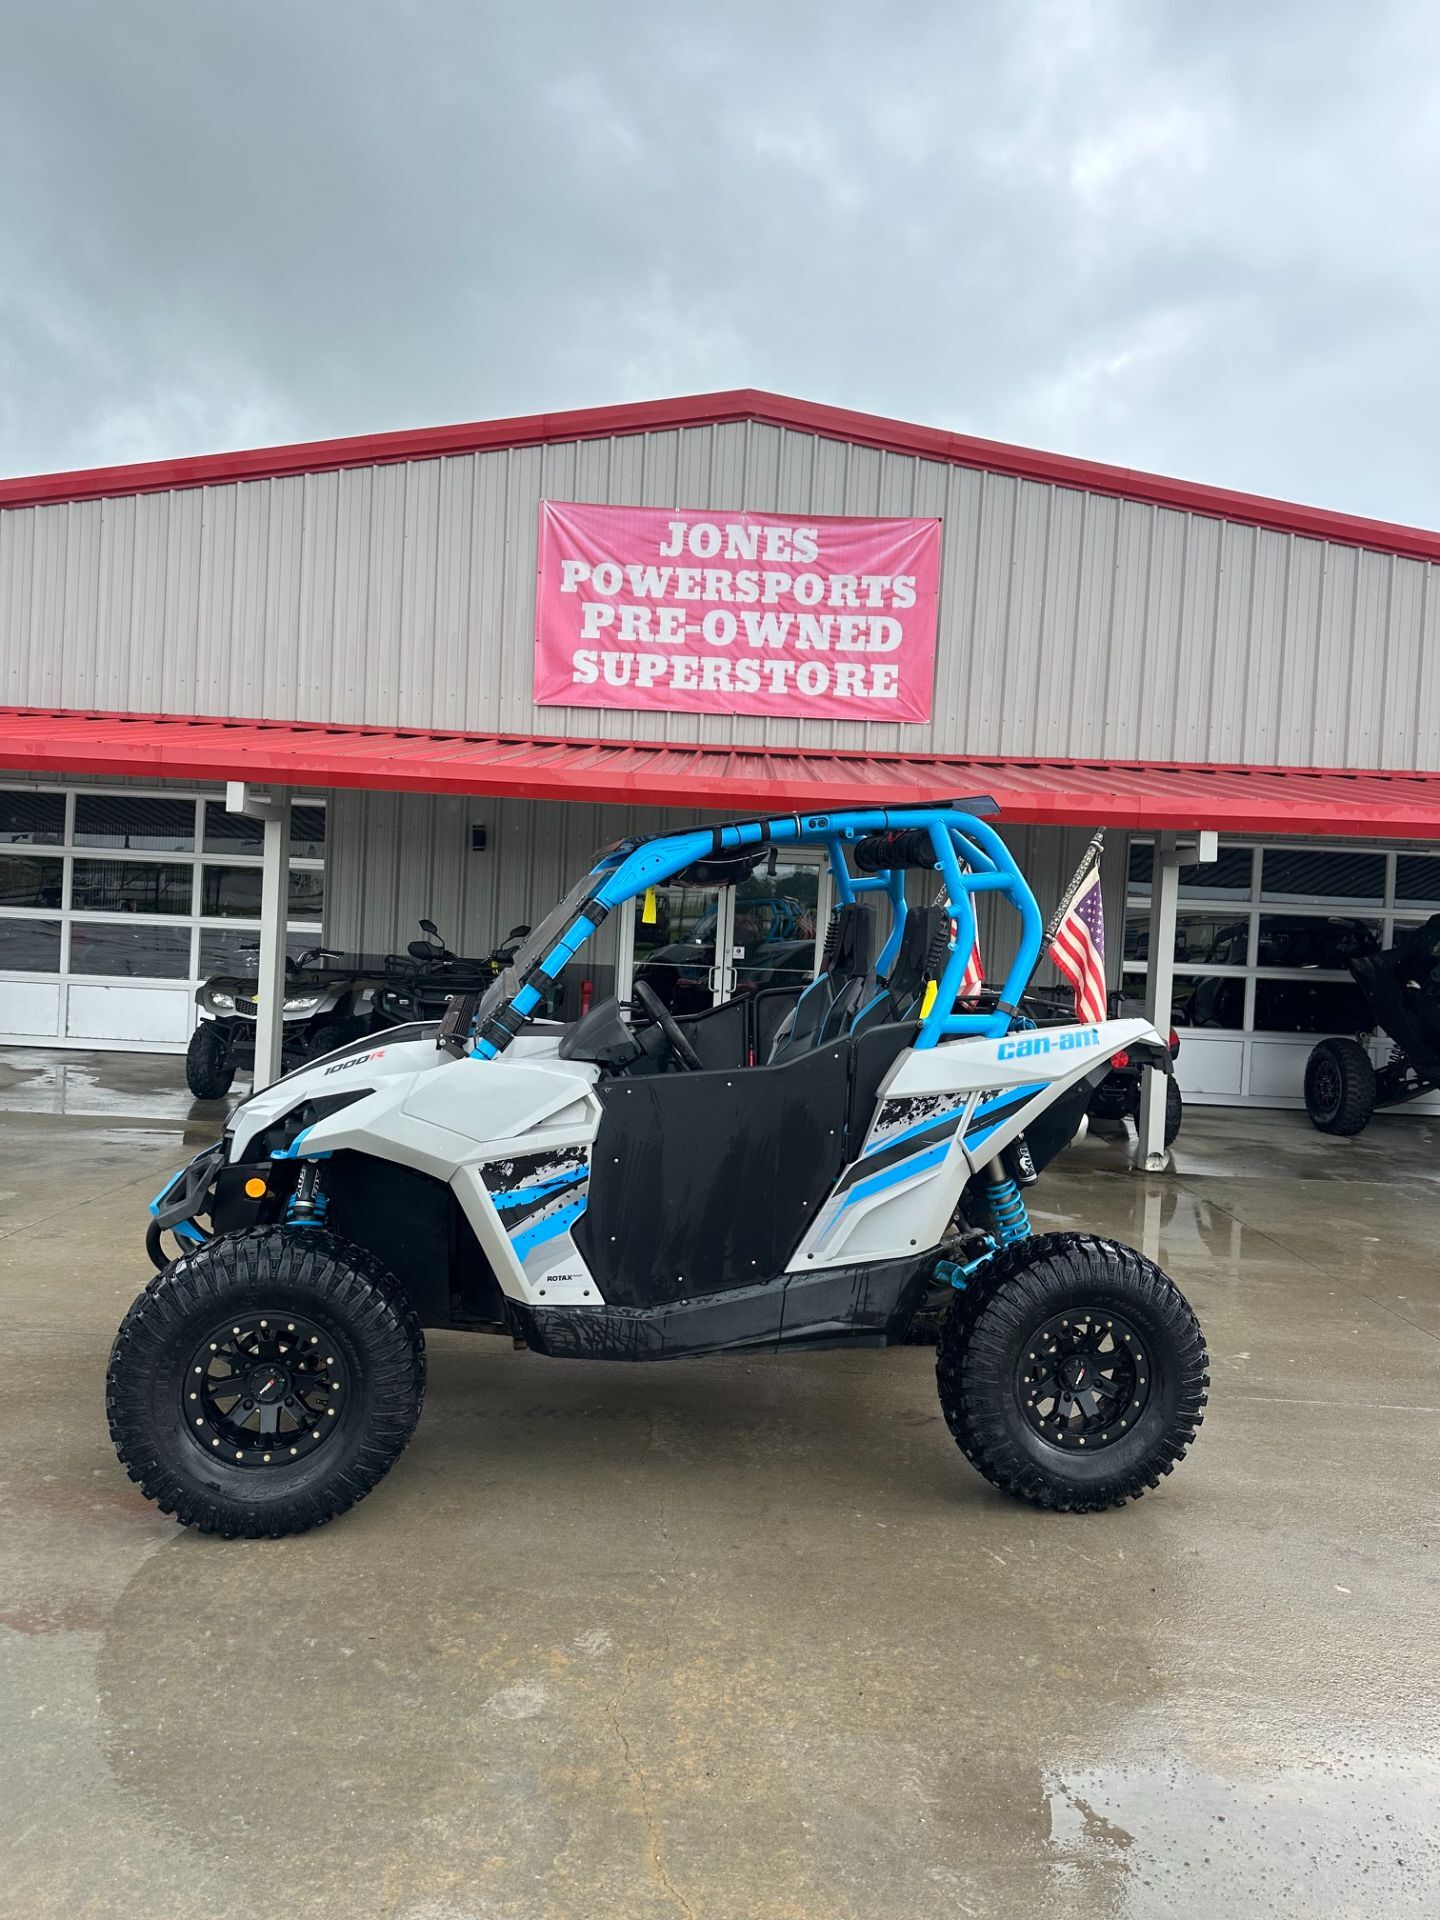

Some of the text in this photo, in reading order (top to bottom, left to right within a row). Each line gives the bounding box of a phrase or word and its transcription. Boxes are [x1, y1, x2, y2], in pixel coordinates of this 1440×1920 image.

[660, 522, 819, 563] JONES
[560, 560, 917, 608] POWERSPORTS
[580, 602, 903, 652] PRE-OWNED
[572, 649, 899, 698] SUPERSTORE
[324, 1050, 386, 1076] 1000R
[546, 1274, 573, 1282] ROTAX
